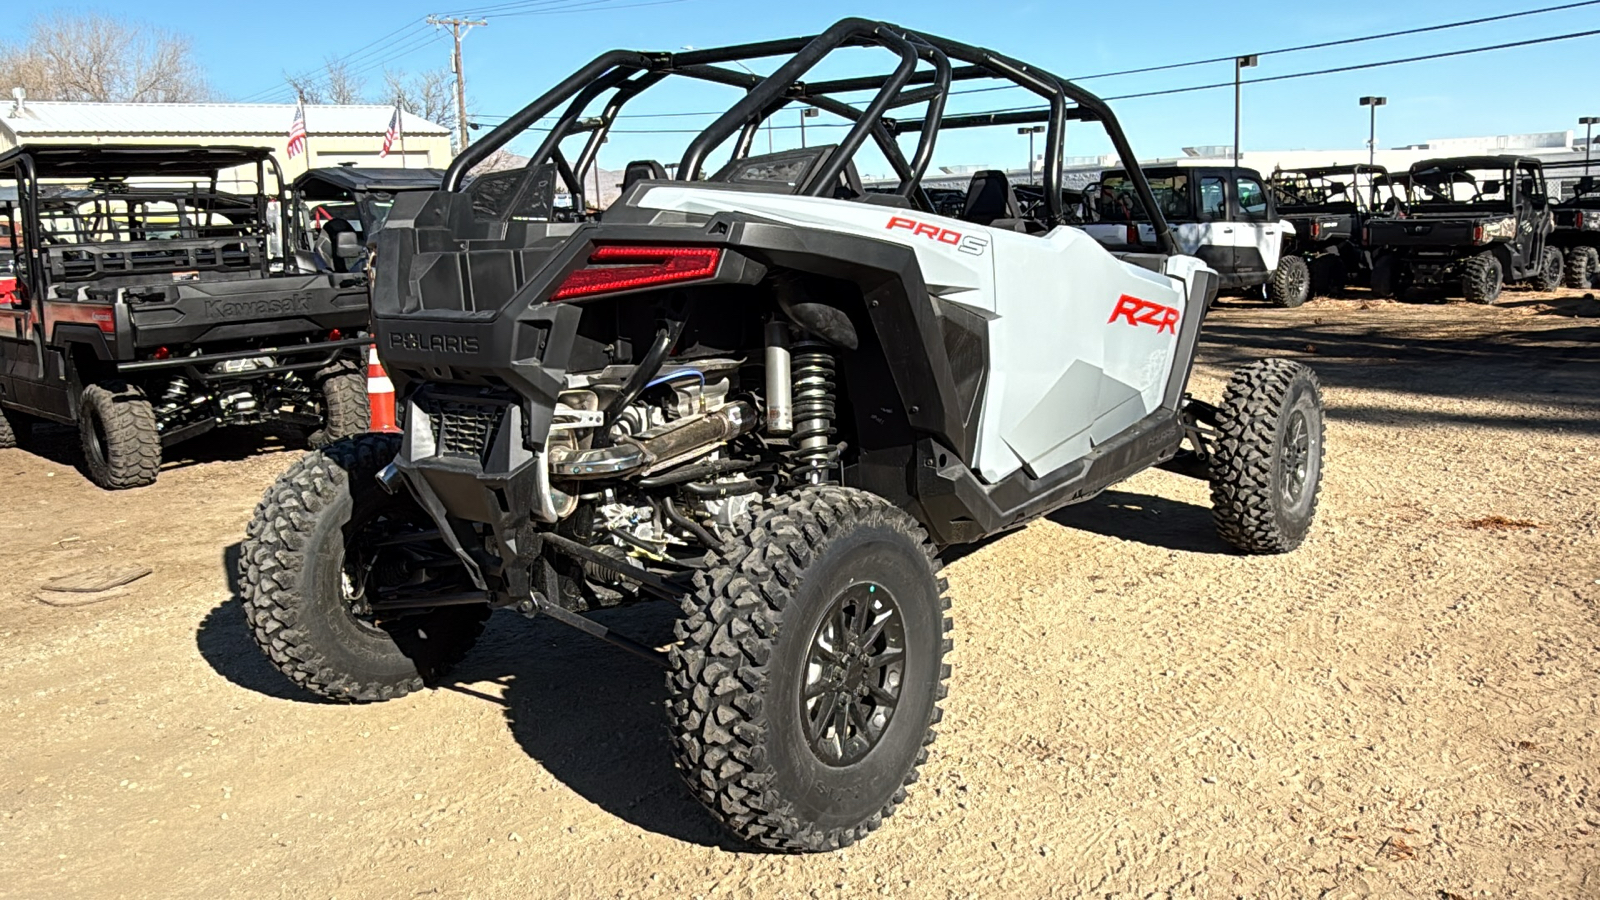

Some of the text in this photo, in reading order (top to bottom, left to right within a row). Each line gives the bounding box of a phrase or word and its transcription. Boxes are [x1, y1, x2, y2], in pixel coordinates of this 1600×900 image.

[885, 216, 988, 256] PRO S
[204, 293, 313, 318] Kawasaki
[1106, 293, 1180, 335] RZR
[389, 332, 479, 354] POLARIS
